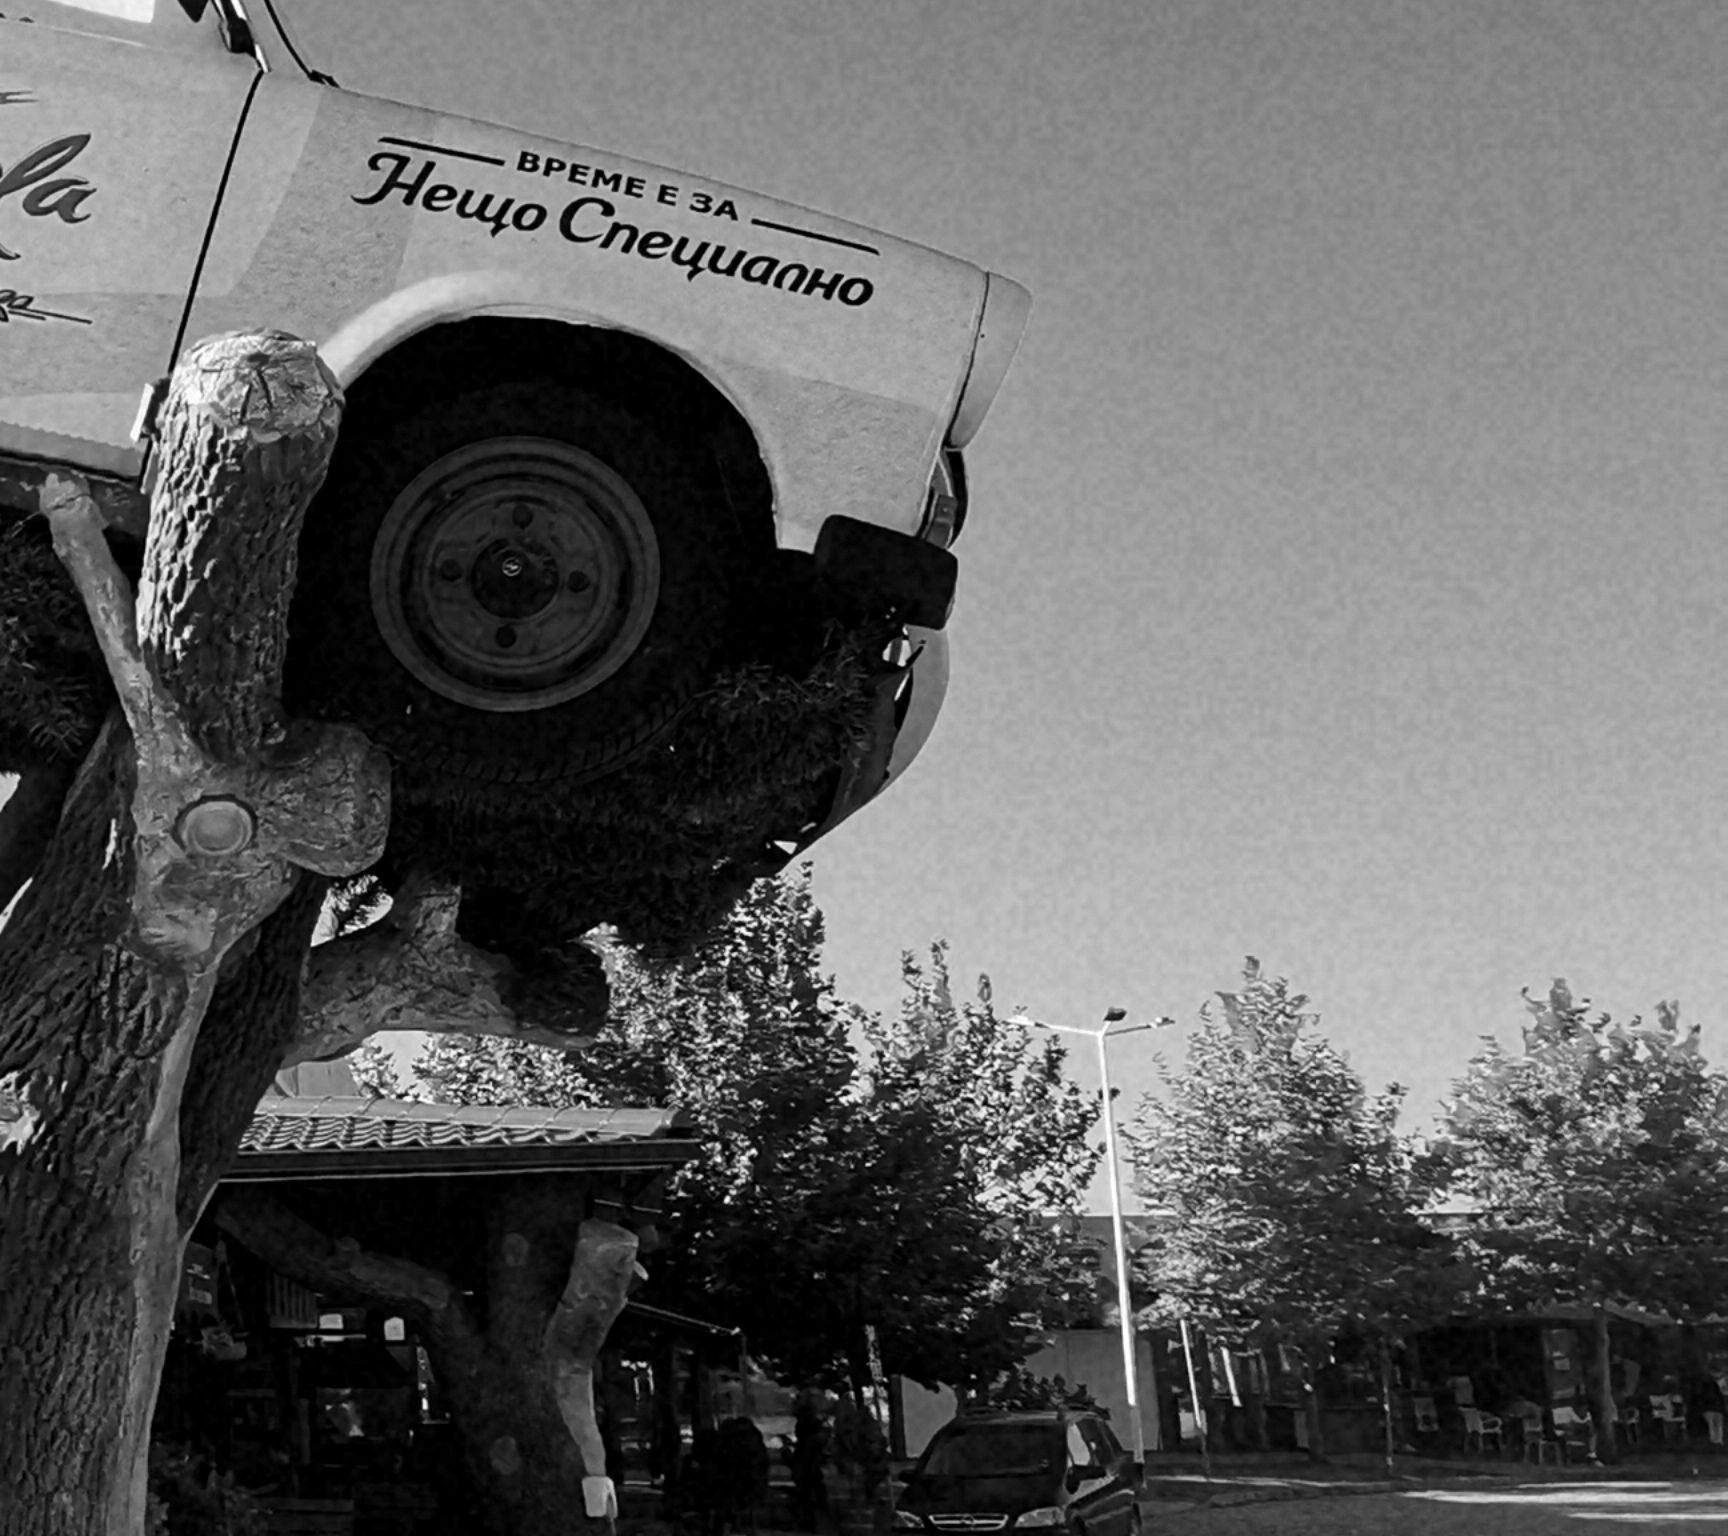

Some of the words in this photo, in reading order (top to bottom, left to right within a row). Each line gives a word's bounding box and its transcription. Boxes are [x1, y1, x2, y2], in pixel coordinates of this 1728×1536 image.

[350, 150, 547, 238] Нещо
[558, 195, 874, 307] Специално
[515, 150, 647, 199] ВРЕМЕ
[656, 183, 679, 206] Е
[689, 191, 740, 221] ЗА
